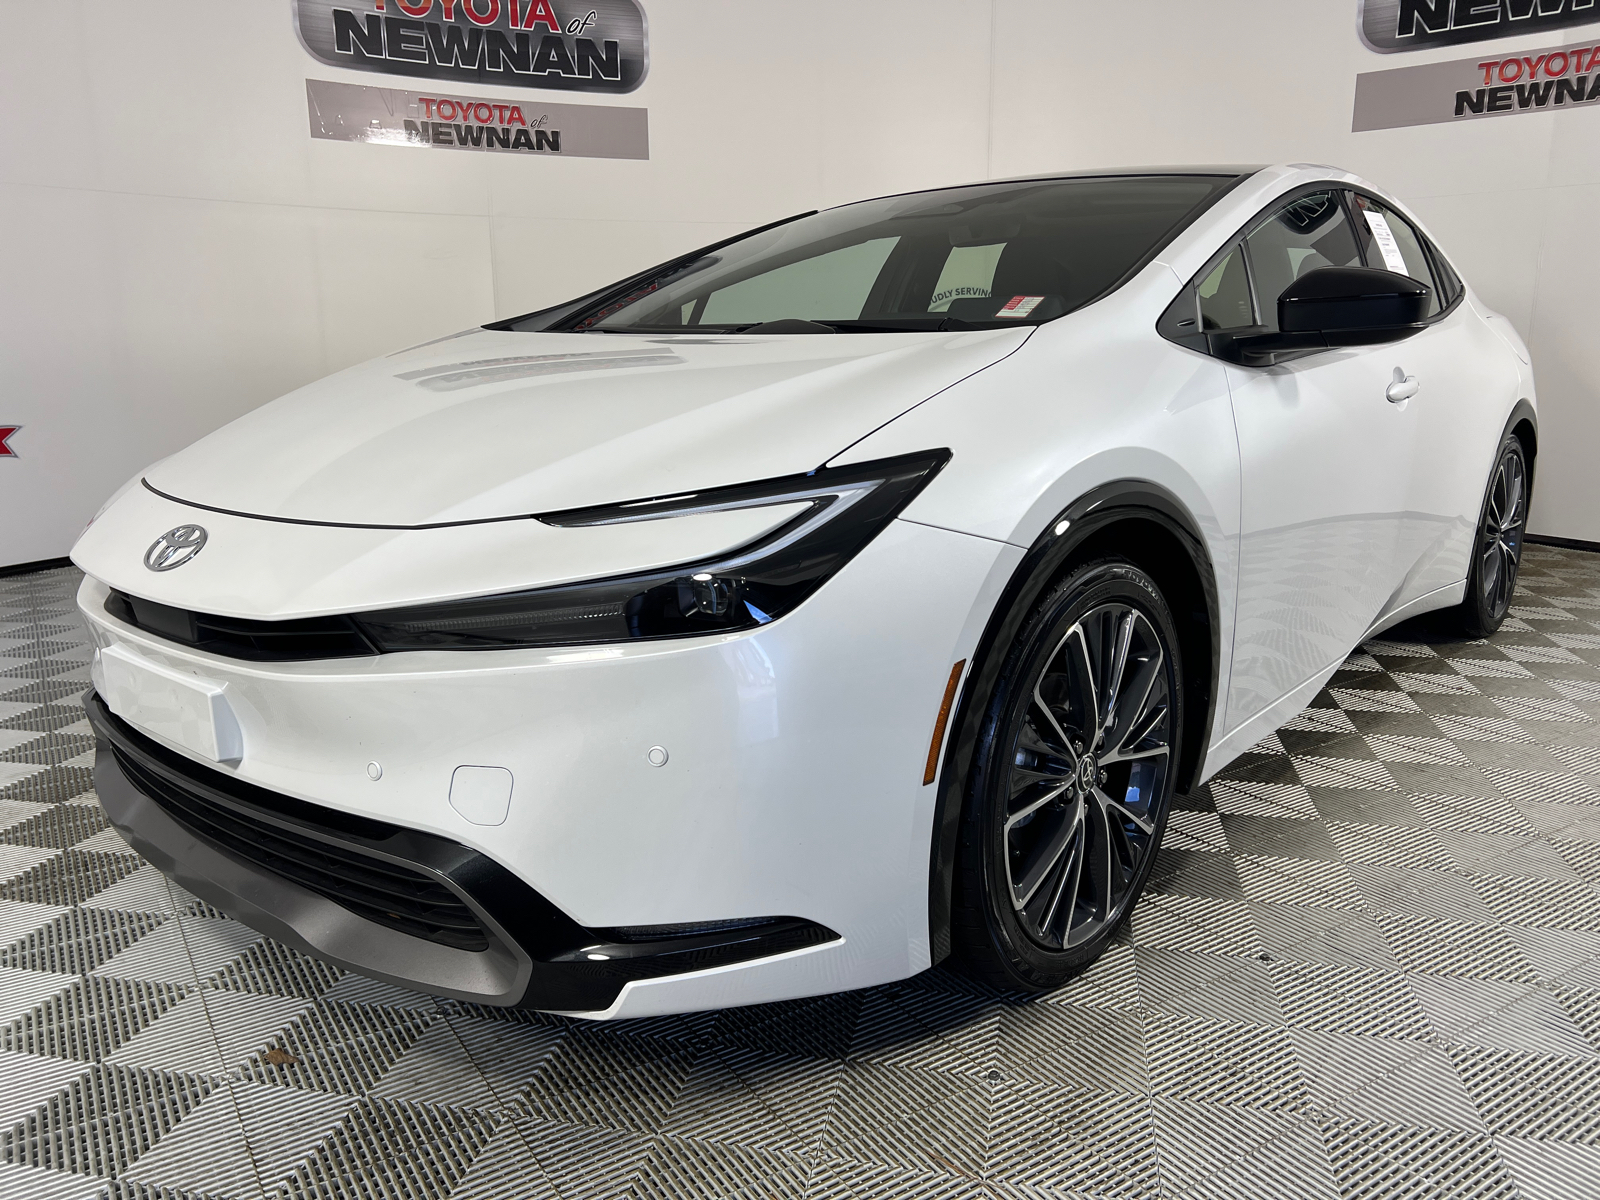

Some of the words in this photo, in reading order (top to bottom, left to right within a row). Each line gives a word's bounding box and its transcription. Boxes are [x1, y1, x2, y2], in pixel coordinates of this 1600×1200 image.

[374, 0, 562, 33] YOTA
[566, 11, 597, 35] of
[332, 9, 621, 80] NEWNAN
[418, 97, 527, 127] TOYOTA
[530, 114, 549, 129] of
[403, 119, 562, 153] NEWNAN
[931, 290, 953, 304] UDLY
